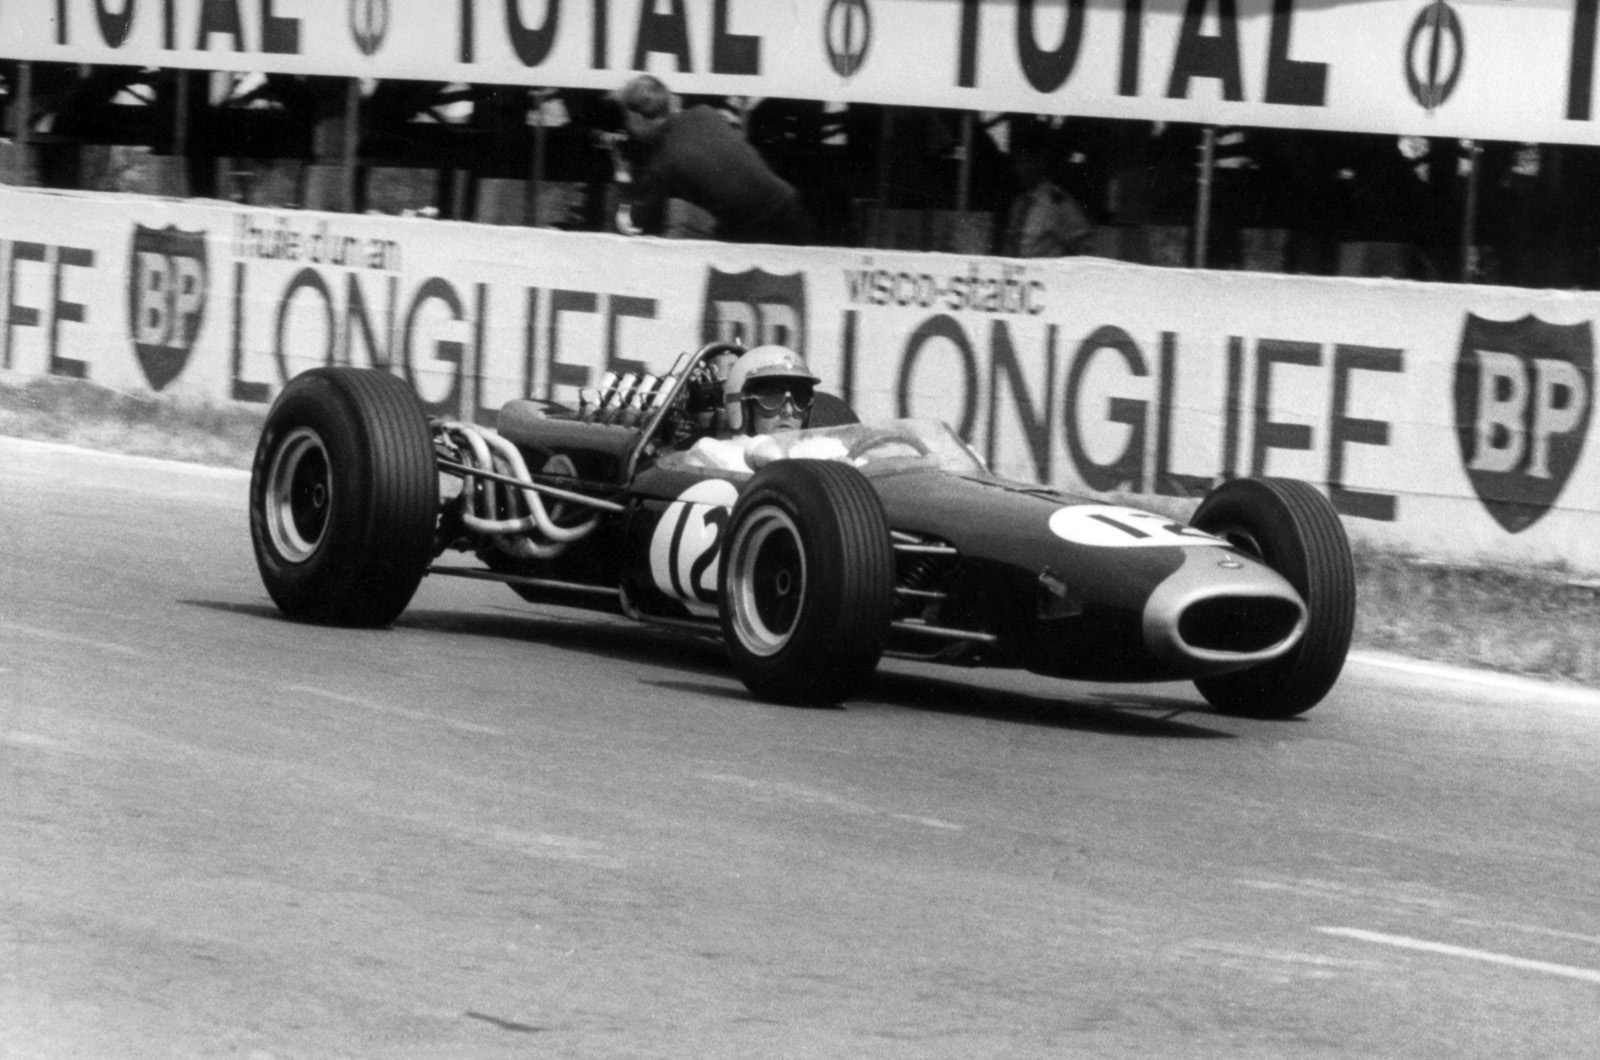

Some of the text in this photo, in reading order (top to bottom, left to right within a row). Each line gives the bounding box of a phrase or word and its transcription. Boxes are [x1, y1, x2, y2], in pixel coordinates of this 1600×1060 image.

[136, 251, 203, 350] BP
[228, 261, 660, 428] LONGLIFE
[840, 309, 1407, 522] LONGLIFE
[1465, 350, 1589, 479] BP
[668, 502, 729, 605] 12
